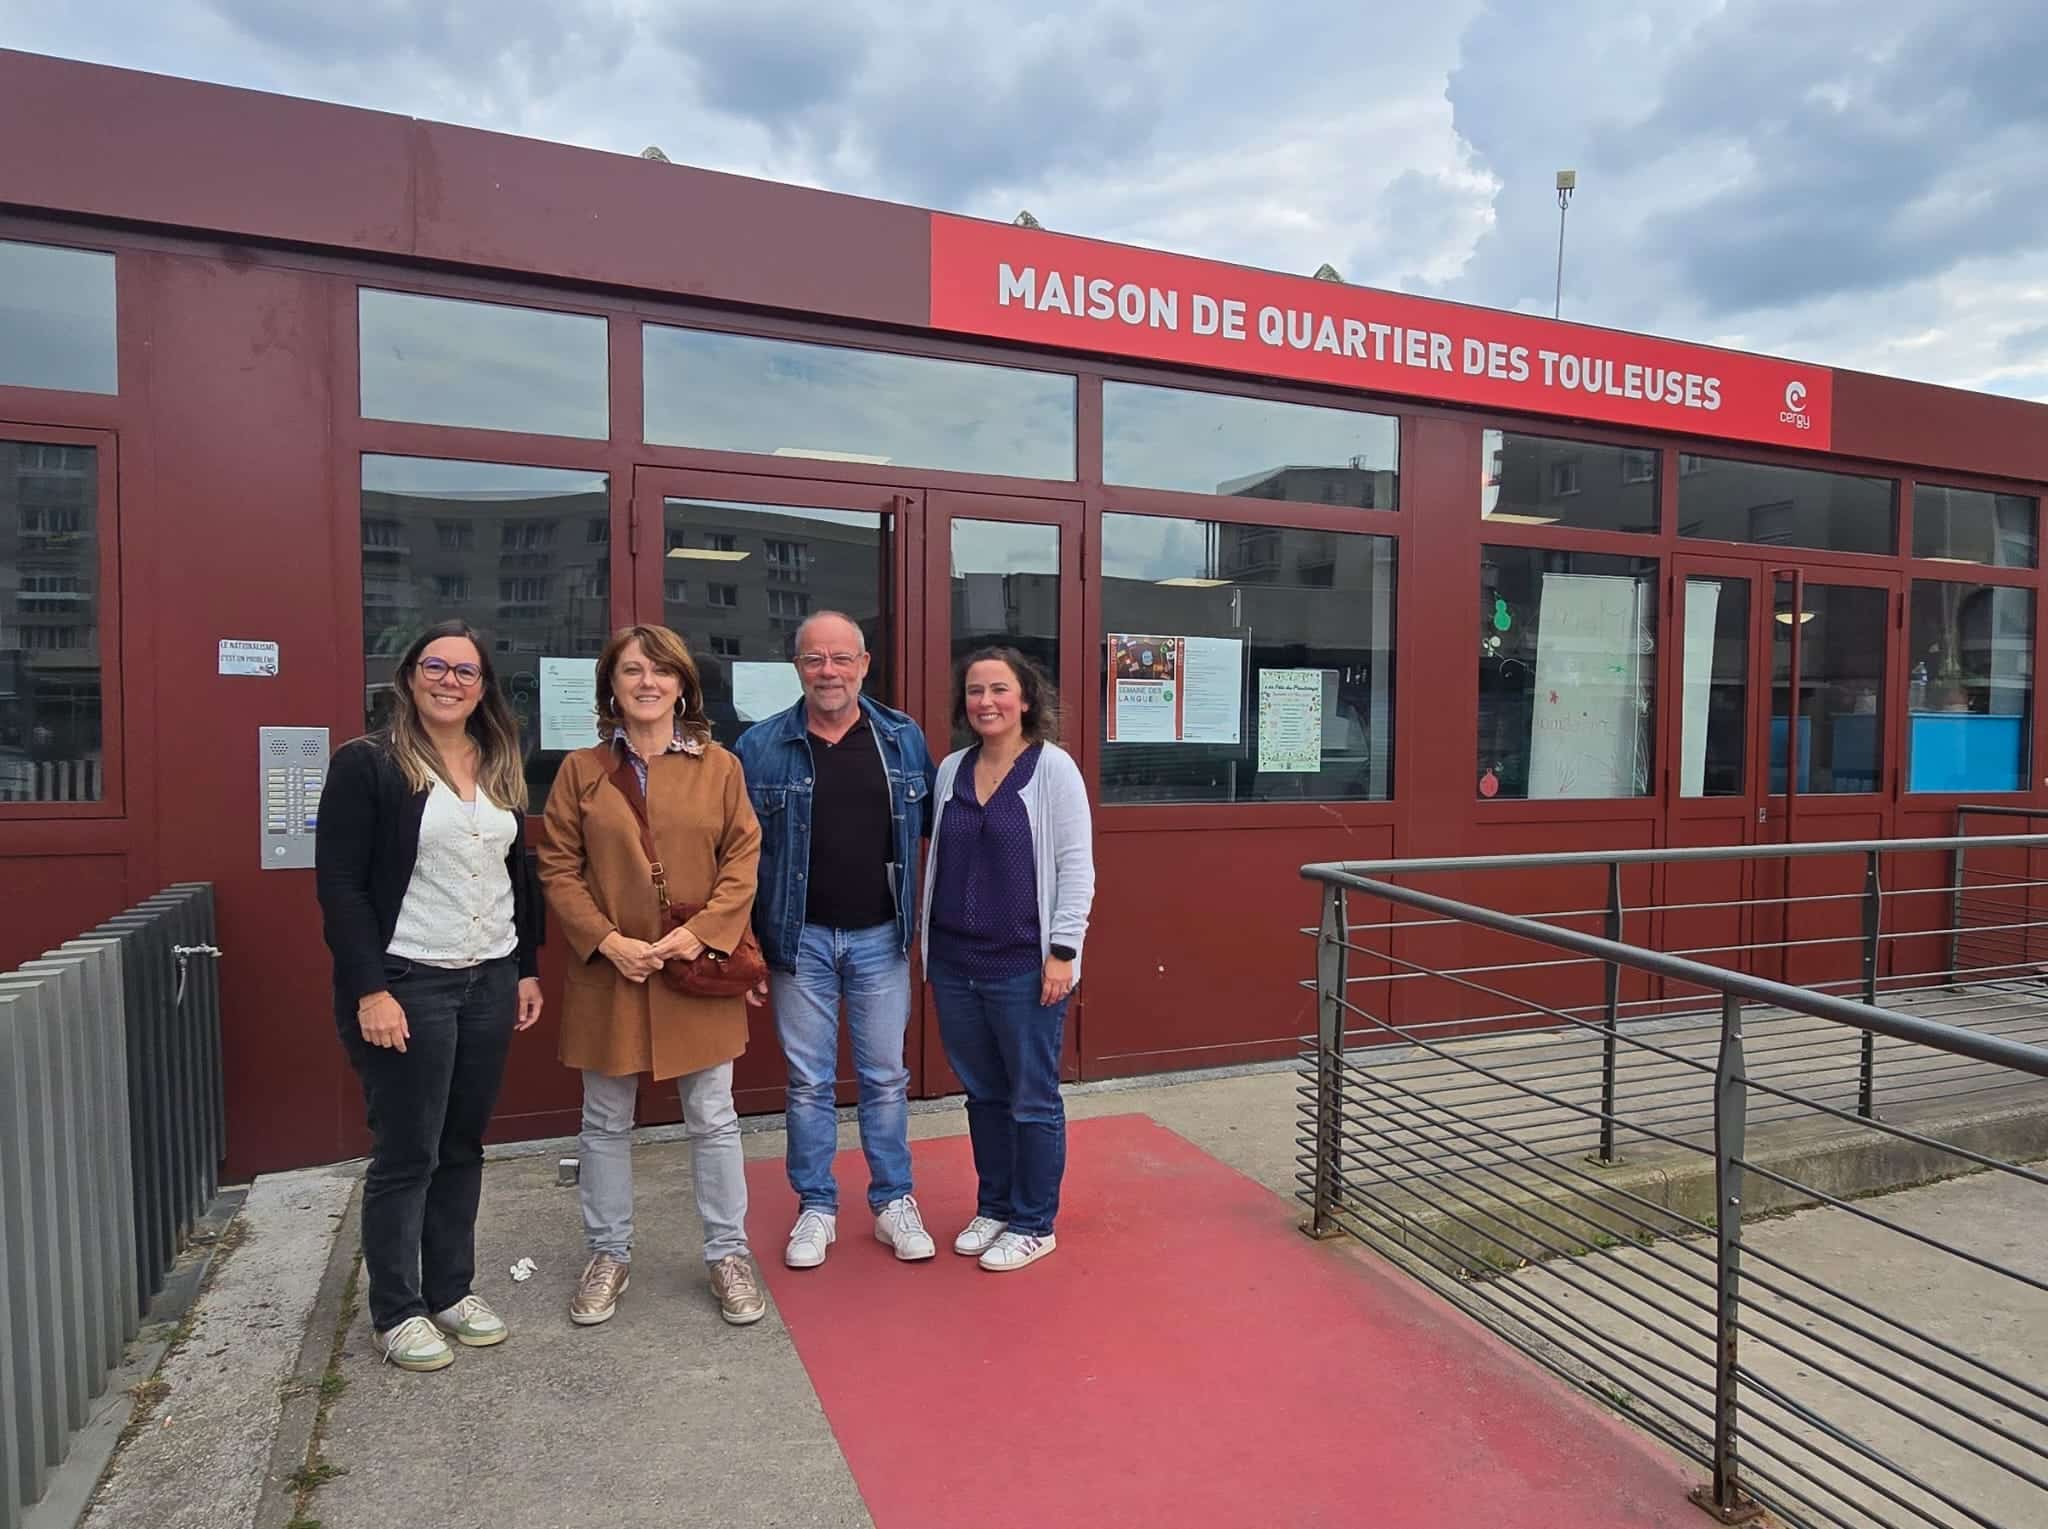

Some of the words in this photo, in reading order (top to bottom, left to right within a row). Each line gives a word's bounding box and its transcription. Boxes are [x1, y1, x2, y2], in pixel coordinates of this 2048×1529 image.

[999, 263, 1178, 331] MAISON
[1192, 294, 1247, 341] DE
[1258, 306, 1453, 372] QUARTIER
[1463, 338, 1529, 382] DES
[1538, 350, 1721, 411] TOULEUSES
[1780, 411, 1811, 430] cergy
